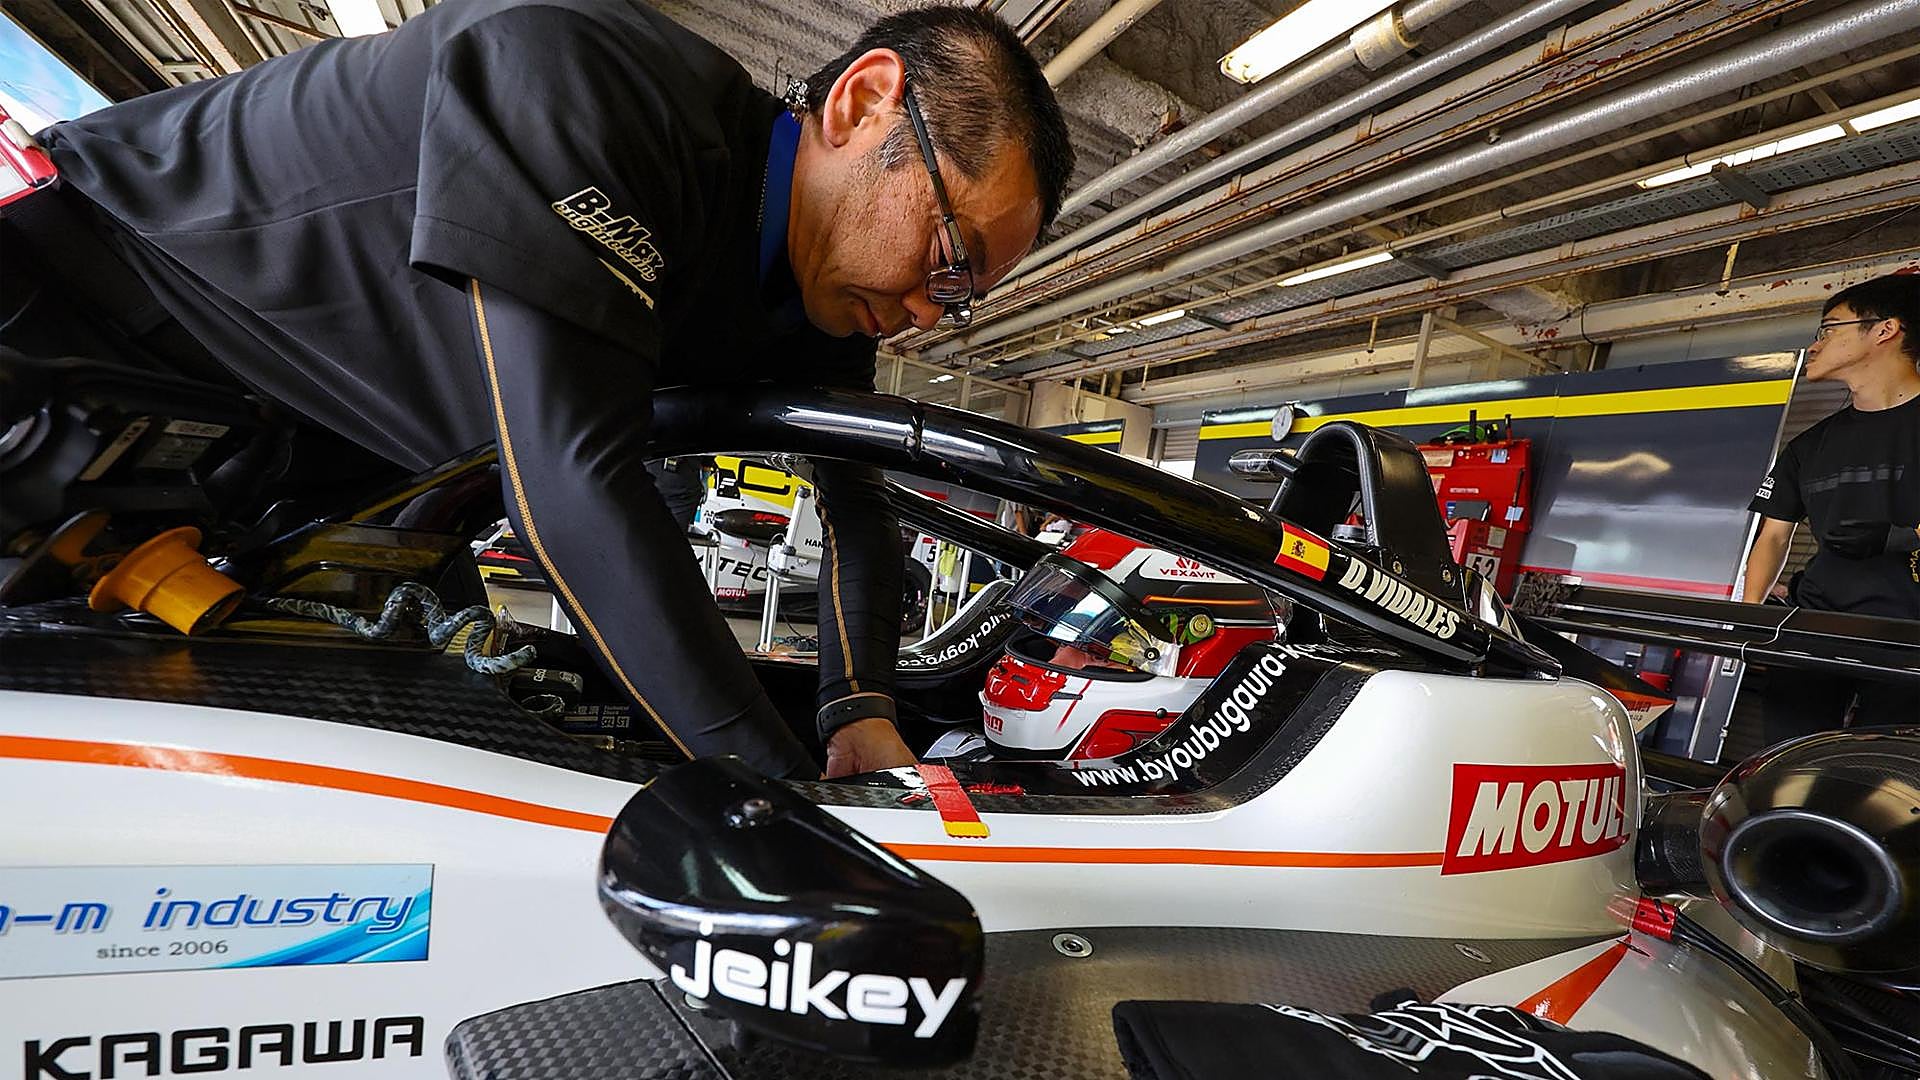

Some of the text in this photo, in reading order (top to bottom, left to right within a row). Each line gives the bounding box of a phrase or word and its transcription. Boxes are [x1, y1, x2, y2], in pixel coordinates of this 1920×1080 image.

[717, 588, 747, 598] MOTUL
[1159, 568, 1217, 579] VEXAVIT
[1337, 556, 1461, 640] D.VIDALES
[1455, 775, 1622, 858] MOTUL
[142, 886, 414, 935] industry
[96, 939, 229, 960] since 2006
[669, 919, 968, 1039] jeikey
[24, 1015, 425, 1080] KAGAWA
